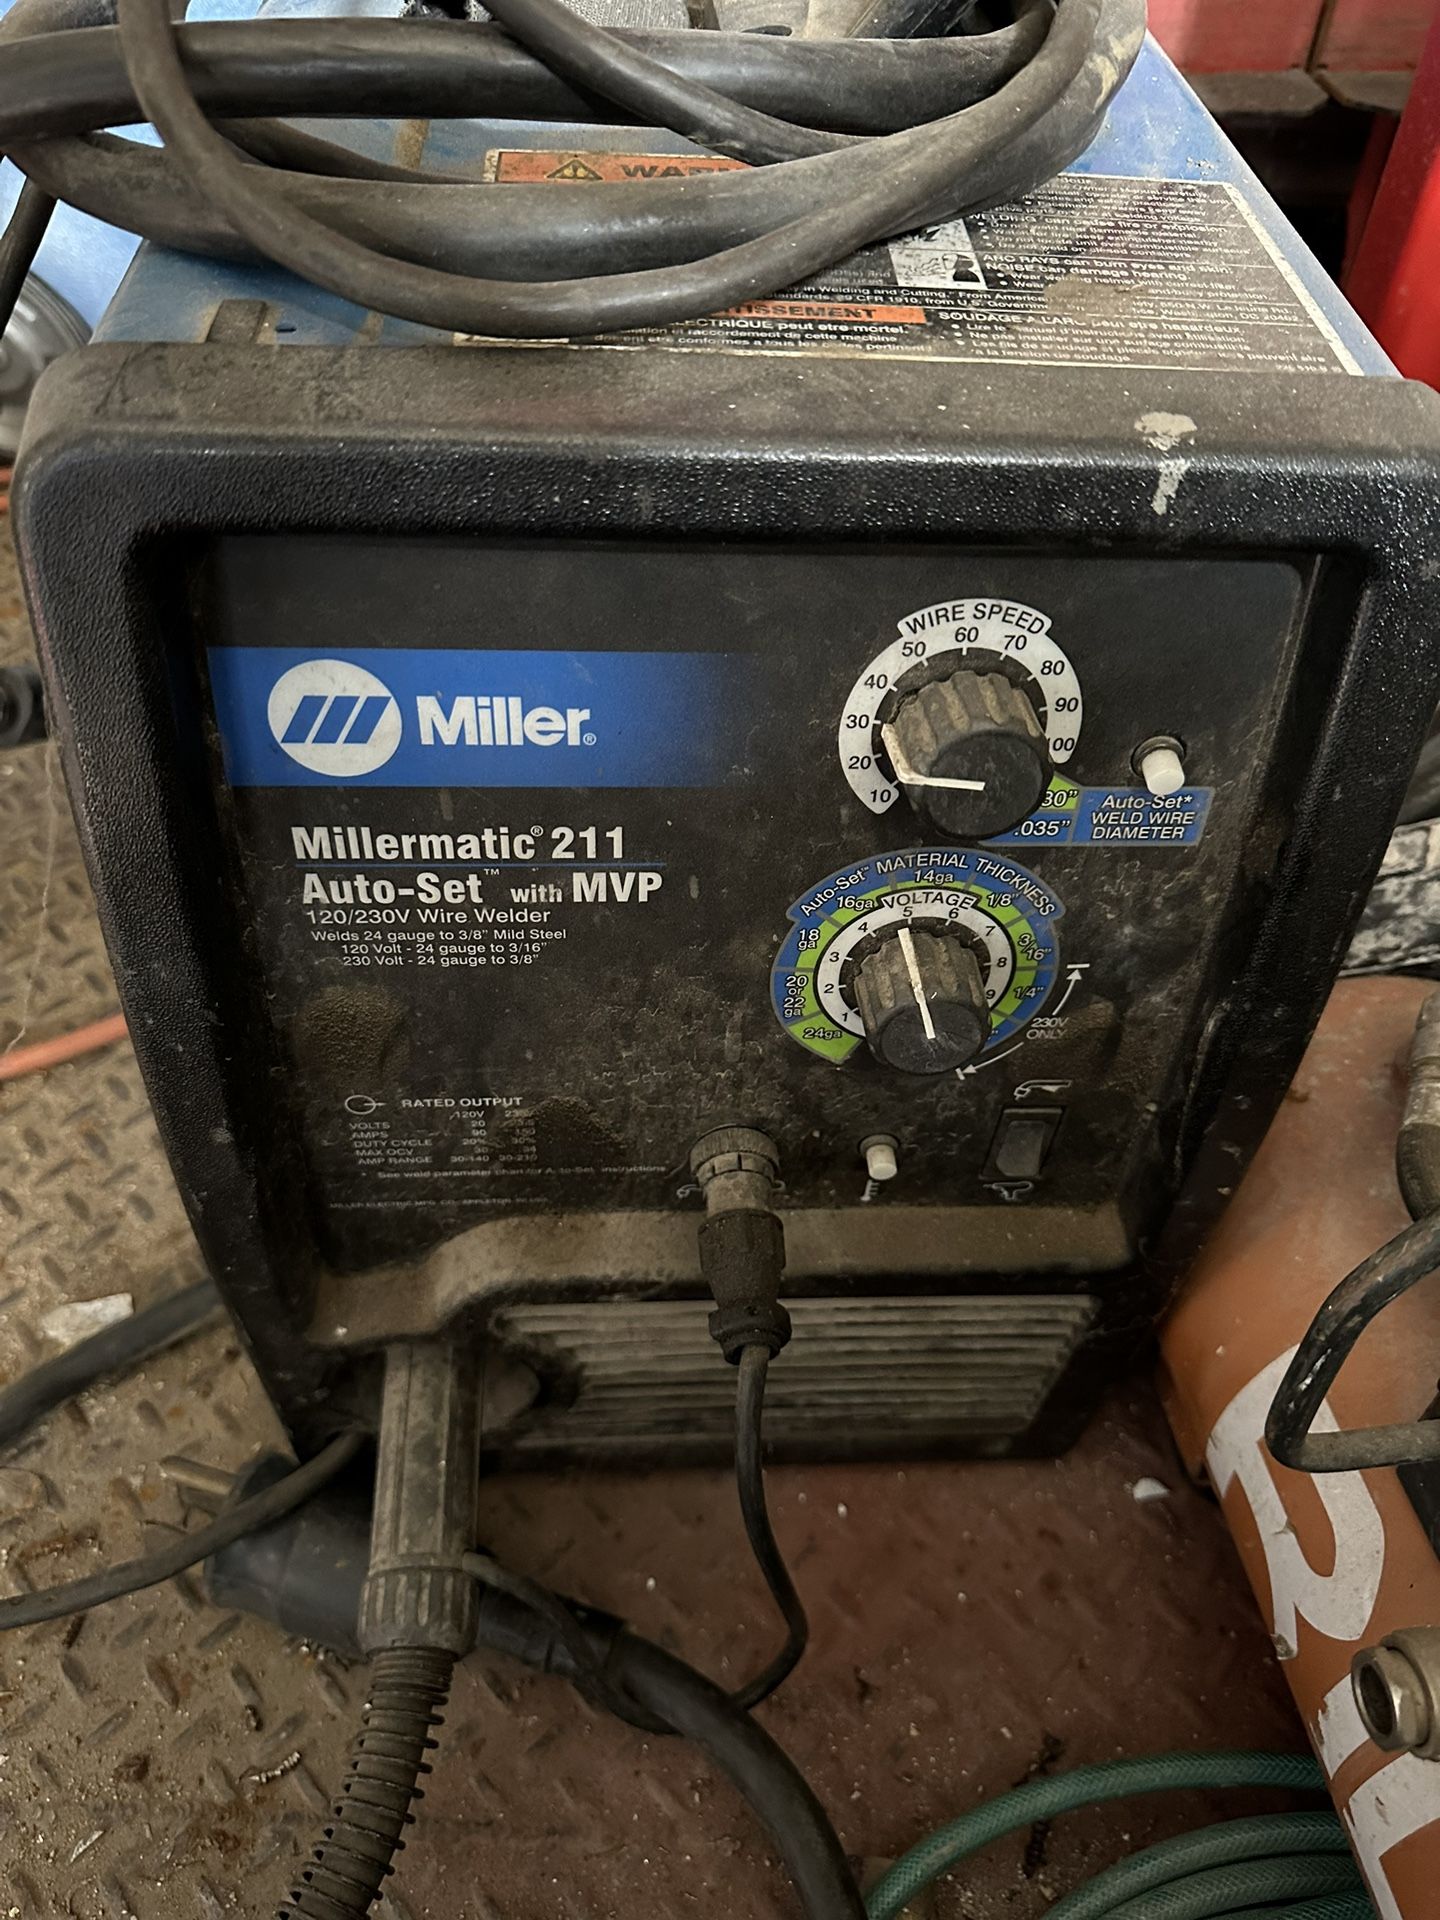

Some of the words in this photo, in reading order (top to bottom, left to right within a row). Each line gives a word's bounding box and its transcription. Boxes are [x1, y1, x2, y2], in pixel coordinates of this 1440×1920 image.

[819, 286, 870, 295] Welding
[939, 312, 1022, 323] SOUDAGE
[778, 322, 814, 331] peut
[852, 324, 908, 334] mortel.
[905, 603, 965, 634] WIRE
[972, 602, 1045, 634] SPEED
[954, 626, 979, 643] 60
[1003, 634, 1027, 650] 70
[901, 641, 927, 657] 50
[1040, 660, 1065, 675] 80
[864, 674, 888, 689] 40
[1054, 697, 1079, 712] 90
[845, 714, 870, 729] 30
[1051, 738, 1075, 752] 00
[848, 755, 872, 770] 20
[870, 789, 892, 803] 10
[1092, 812, 1144, 825] WELD
[1149, 812, 1196, 825] WIRE
[1092, 826, 1184, 839] DIAMETER
[551, 827, 624, 860] 211
[914, 869, 954, 884] 14ga
[510, 883, 562, 903] with
[572, 872, 663, 902] MVP
[876, 853, 969, 875] MATERIAL
[975, 857, 1056, 917] THICKNESS
[836, 896, 874, 911] 16ga
[881, 891, 979, 910] VOLTAGE
[305, 909, 410, 925] 120/230V
[417, 908, 469, 923] Wire
[474, 908, 552, 923] Welder
[902, 907, 913, 918] 5
[948, 907, 959, 919] 6
[857, 922, 869, 933] 4
[985, 925, 996, 937] 7
[311, 930, 360, 941] Welds
[364, 930, 383, 941] 24
[387, 930, 435, 944] gauge
[439, 930, 455, 941] to
[494, 928, 526, 940] Mild
[529, 928, 567, 940] Steel
[798, 929, 819, 942] 18
[341, 943, 369, 954] 120
[372, 943, 402, 954] Volt
[416, 943, 434, 953] 24
[439, 943, 486, 956] gauge
[490, 942, 506, 953] to
[798, 938, 817, 952] ga
[343, 955, 370, 966] 230
[374, 955, 404, 966] Volt
[417, 955, 436, 965] 24
[440, 955, 487, 968] gauge
[491, 954, 506, 965] to
[829, 952, 840, 963] 3
[997, 957, 1007, 968] 8
[786, 976, 808, 988] 20
[788, 986, 804, 995] or
[823, 983, 835, 994] 2
[985, 989, 996, 999] 9
[783, 997, 806, 1008] 22
[783, 1006, 802, 1018] ga
[842, 1012, 849, 1022] 1
[1031, 1017, 1068, 1029] 230V
[802, 1027, 842, 1039] 24ga
[1026, 1029, 1063, 1040] ONLY
[401, 1099, 455, 1108] RATED
[460, 1097, 523, 1107] OUTPUT
[349, 1121, 391, 1130] VOLTS
[352, 1130, 389, 1139] AMPS
[354, 1139, 387, 1148] DUTY
[391, 1139, 433, 1147] CYCLE
[356, 1148, 382, 1157] MAX
[358, 1157, 386, 1166] AMP
[389, 1155, 433, 1164] RANGE
[433, 1169, 491, 1178] parameter
